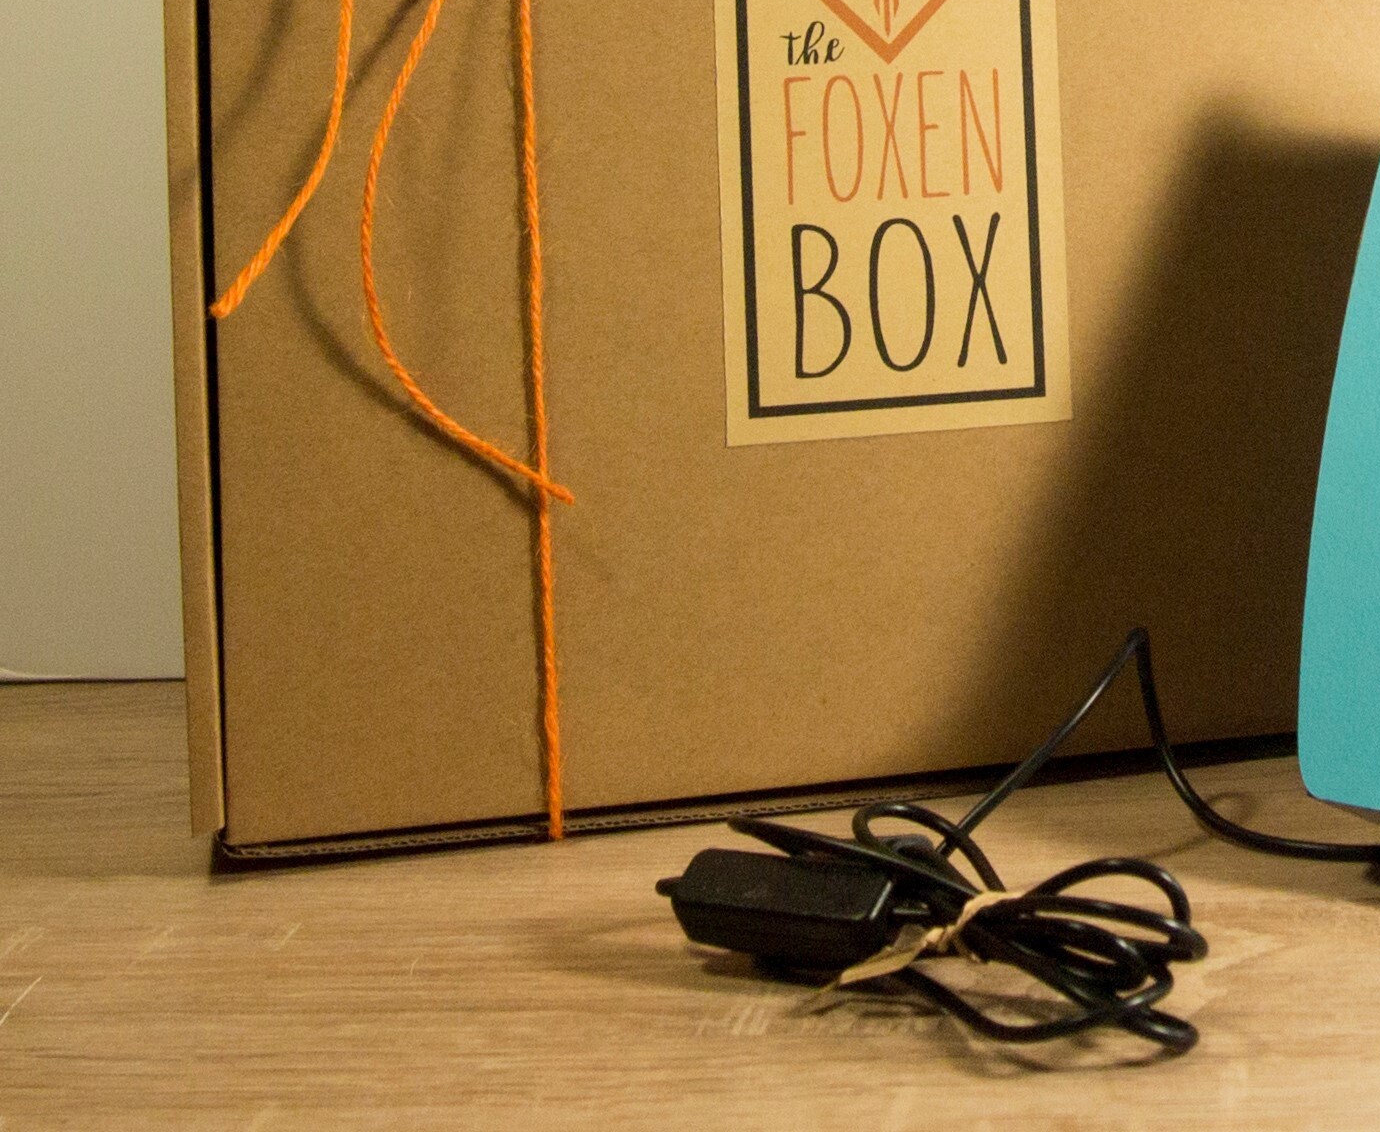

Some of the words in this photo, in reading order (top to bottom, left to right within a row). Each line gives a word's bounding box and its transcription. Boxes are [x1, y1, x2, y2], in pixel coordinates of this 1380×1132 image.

[780, 20, 845, 65] the
[782, 68, 1003, 205] FOXEN
[790, 211, 1008, 379] BOX
